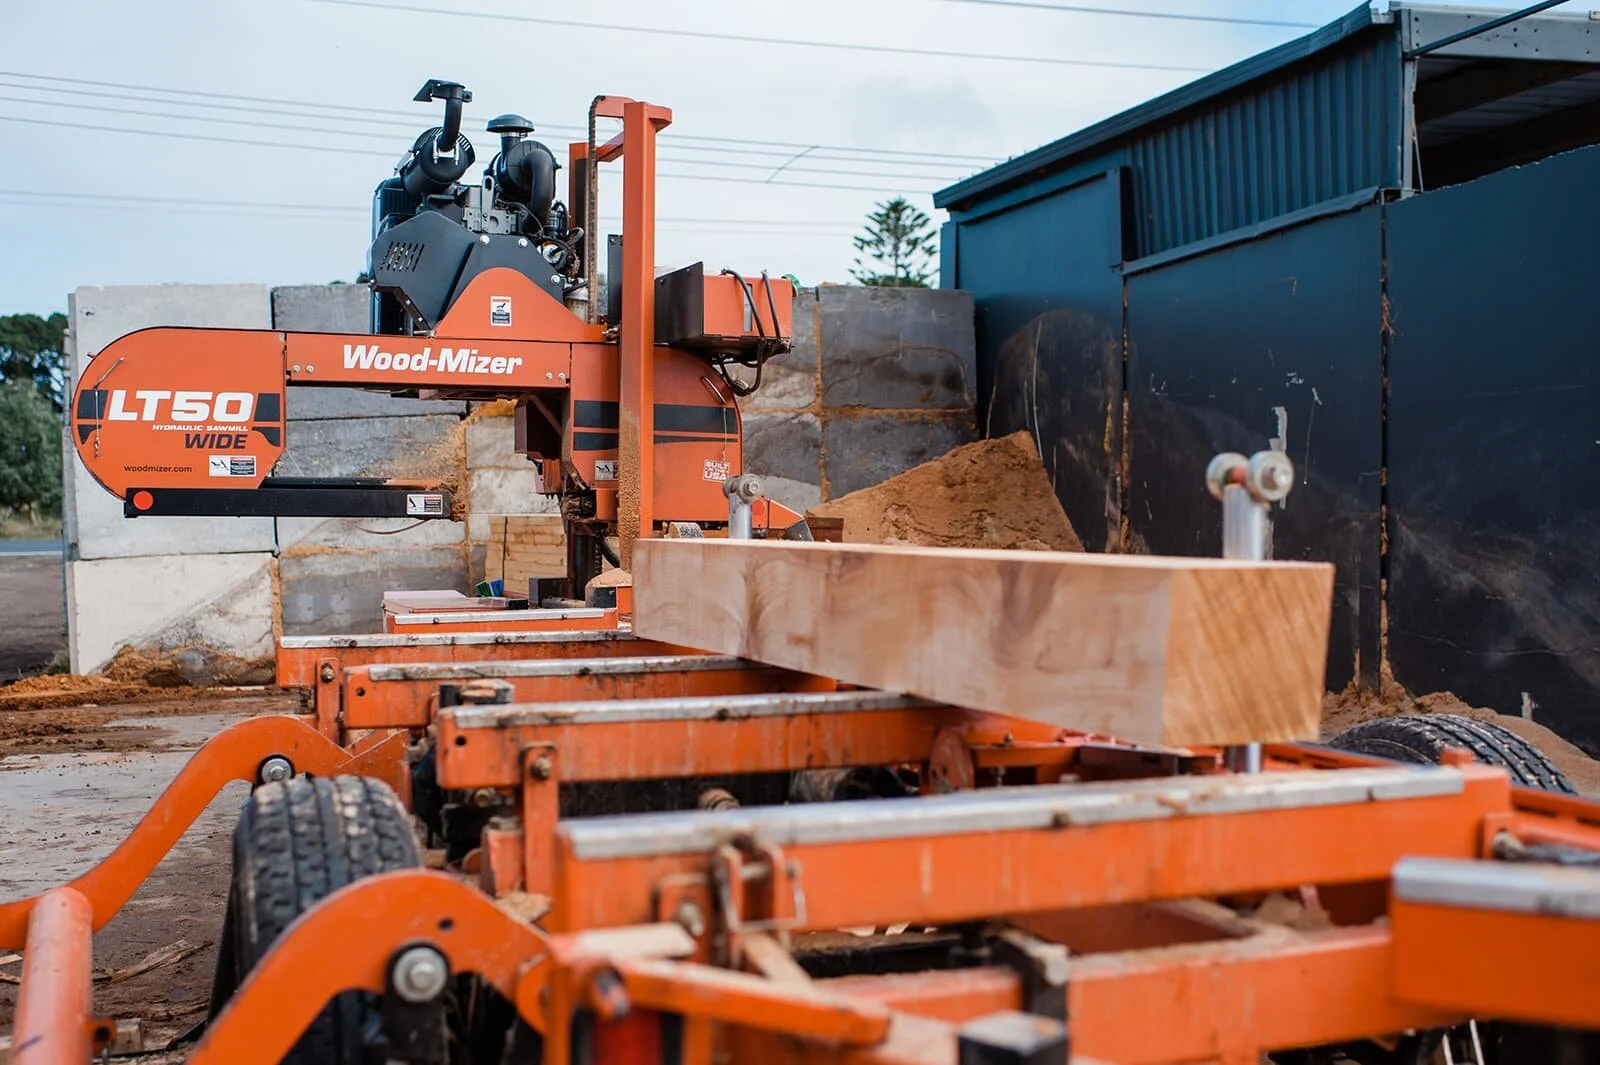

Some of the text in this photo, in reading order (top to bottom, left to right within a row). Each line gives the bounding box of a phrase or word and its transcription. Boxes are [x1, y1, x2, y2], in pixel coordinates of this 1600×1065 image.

[343, 344, 522, 374] Wood-Mizer
[108, 390, 253, 422] LT50
[185, 433, 248, 449] WIDE
[705, 461, 728, 469] BUILT
[704, 471, 726, 480] USA
